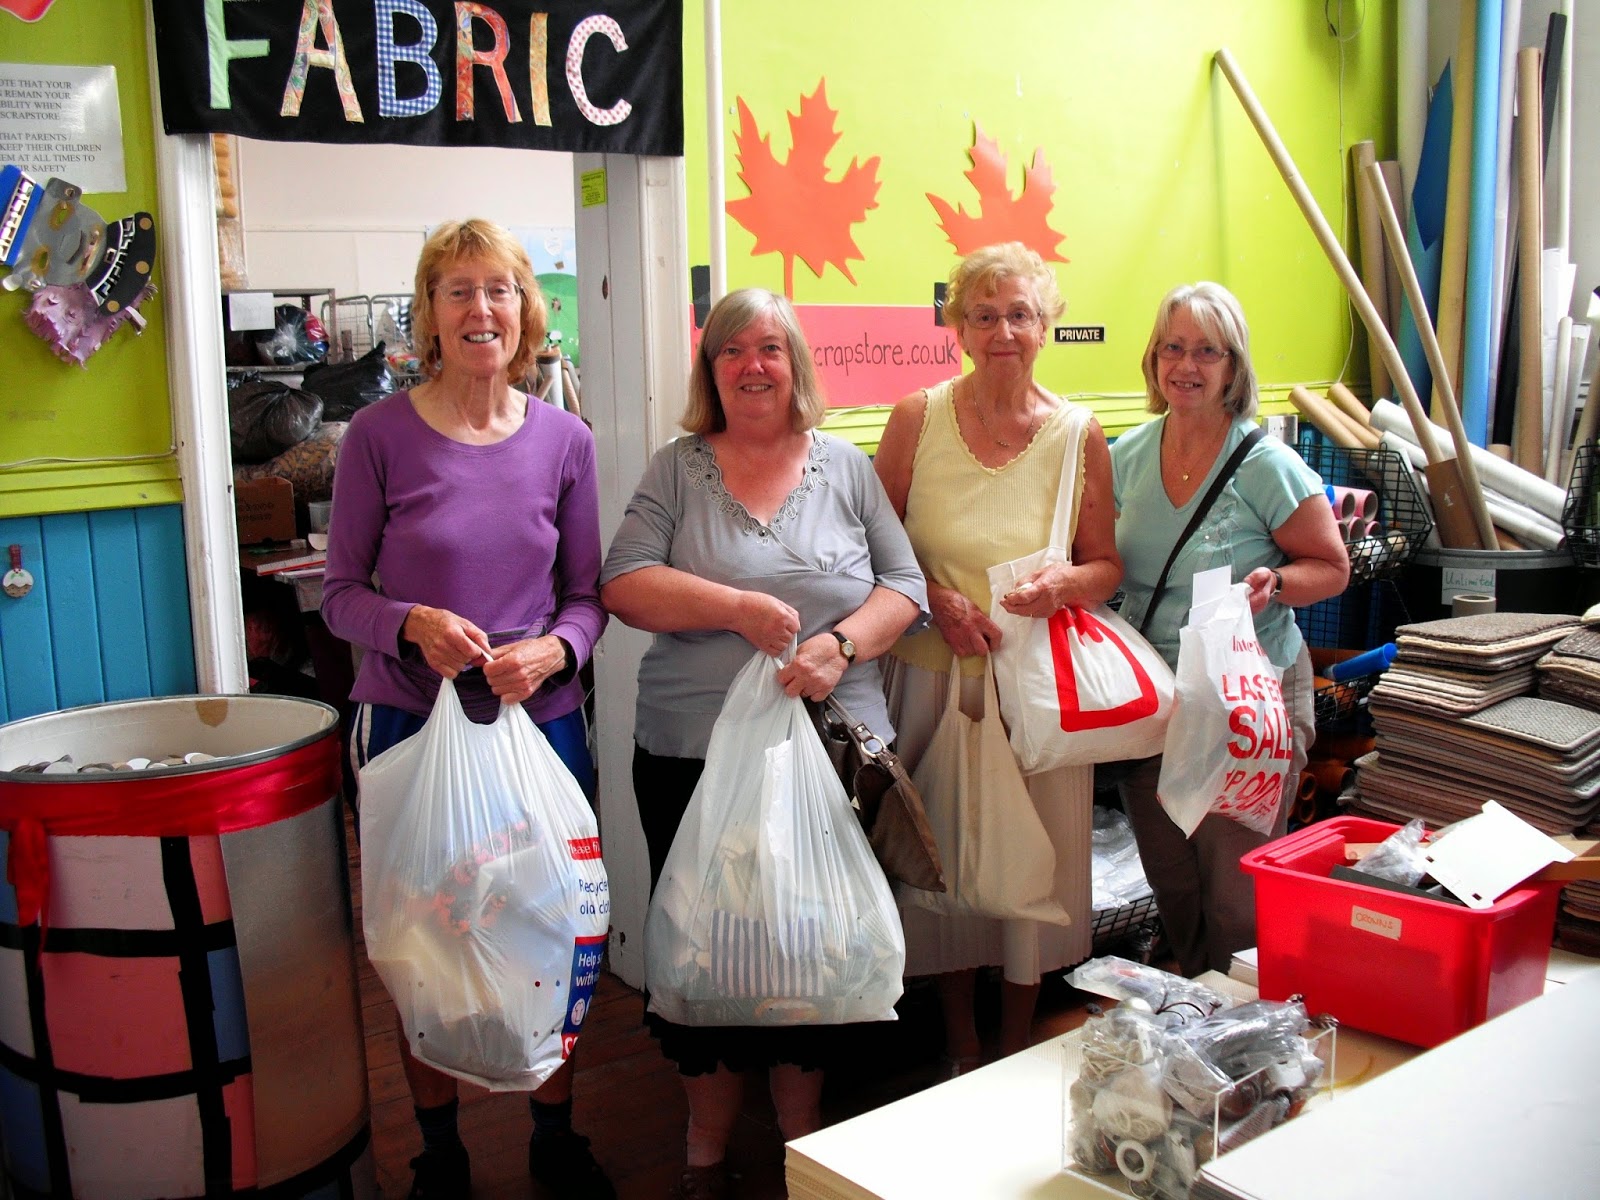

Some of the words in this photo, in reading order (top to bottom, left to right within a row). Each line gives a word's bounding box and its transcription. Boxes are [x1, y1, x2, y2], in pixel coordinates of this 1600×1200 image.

[203, 0, 633, 126] FABRIC
[18, 80, 43, 88] THAT
[45, 81, 72, 89] YOUR
[5, 90, 42, 98] REMAIN
[44, 91, 71, 100] YOUR
[0, 101, 31, 109] BILITY
[34, 102, 62, 110] WHEN
[0, 112, 60, 120] SCRAPSTORE
[0, 132, 22, 140] THAT
[25, 133, 67, 141] PARENTS
[55, 144, 102, 152] CHILDREN
[18, 154, 30, 162] AT
[33, 154, 51, 162] ALL
[53, 154, 81, 162] TIMES
[82, 154, 96, 162] TO
[32, 164, 67, 172] SAFETY
[1059, 329, 1100, 340] PRIVATE
[809, 331, 958, 376] crapstore.co.uk
[1445, 571, 1494, 588] Unlimited
[1227, 705, 1292, 760] SALE
[578, 951, 597, 969] Help
